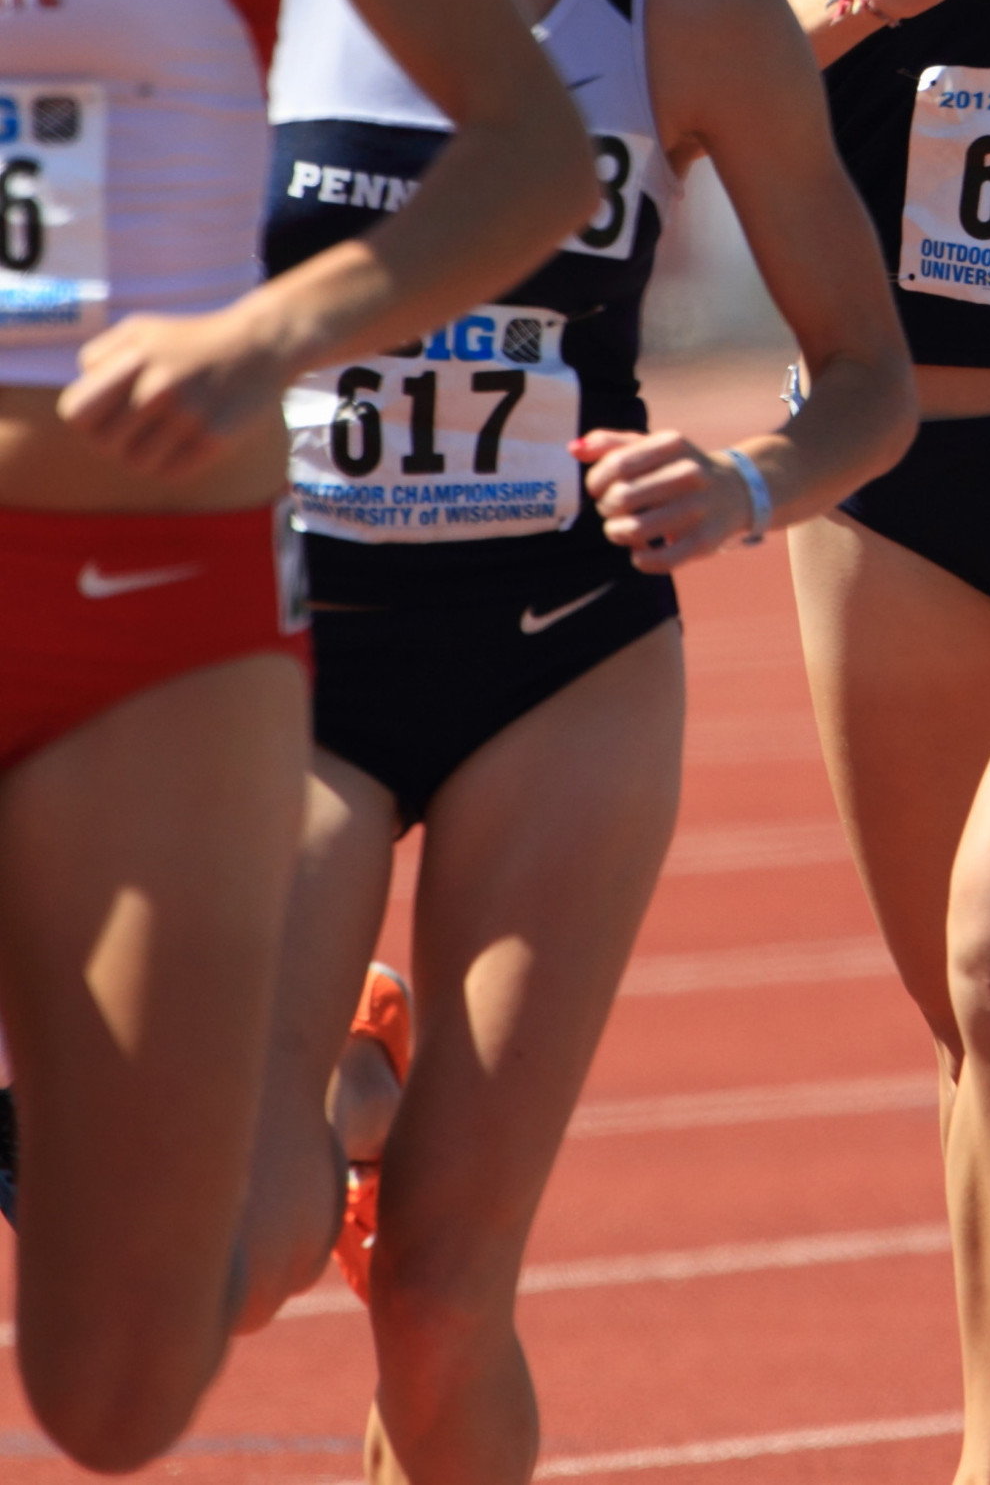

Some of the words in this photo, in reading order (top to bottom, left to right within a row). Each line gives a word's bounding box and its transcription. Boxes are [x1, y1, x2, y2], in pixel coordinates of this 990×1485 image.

[286, 159, 421, 214] PENN
[331, 365, 526, 478] 617
[302, 499, 412, 526] ERSITY
[418, 506, 439, 526] of
[445, 502, 557, 525] WISCONSIN
[391, 480, 558, 505] CHAMPIONSHIPS
